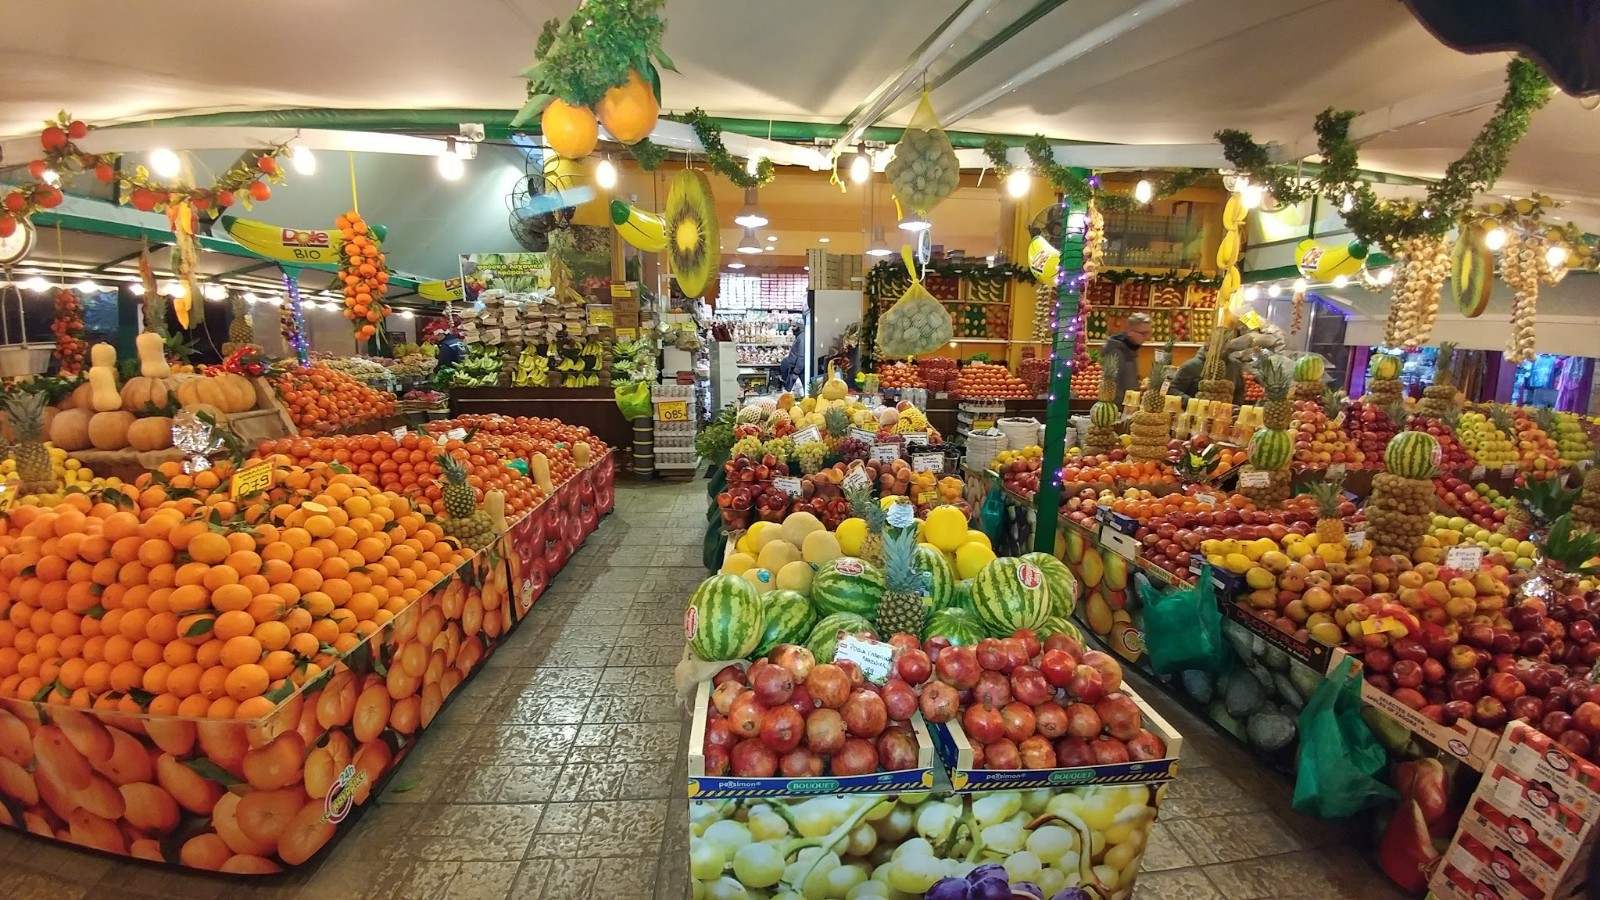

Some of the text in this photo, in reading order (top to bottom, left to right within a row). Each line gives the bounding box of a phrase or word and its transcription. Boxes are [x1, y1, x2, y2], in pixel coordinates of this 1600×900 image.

[283, 229, 328, 243] Dole
[294, 248, 321, 260] BIO
[1053, 770, 1093, 780] BOUQUET
[793, 782, 836, 790] BOUQUET
